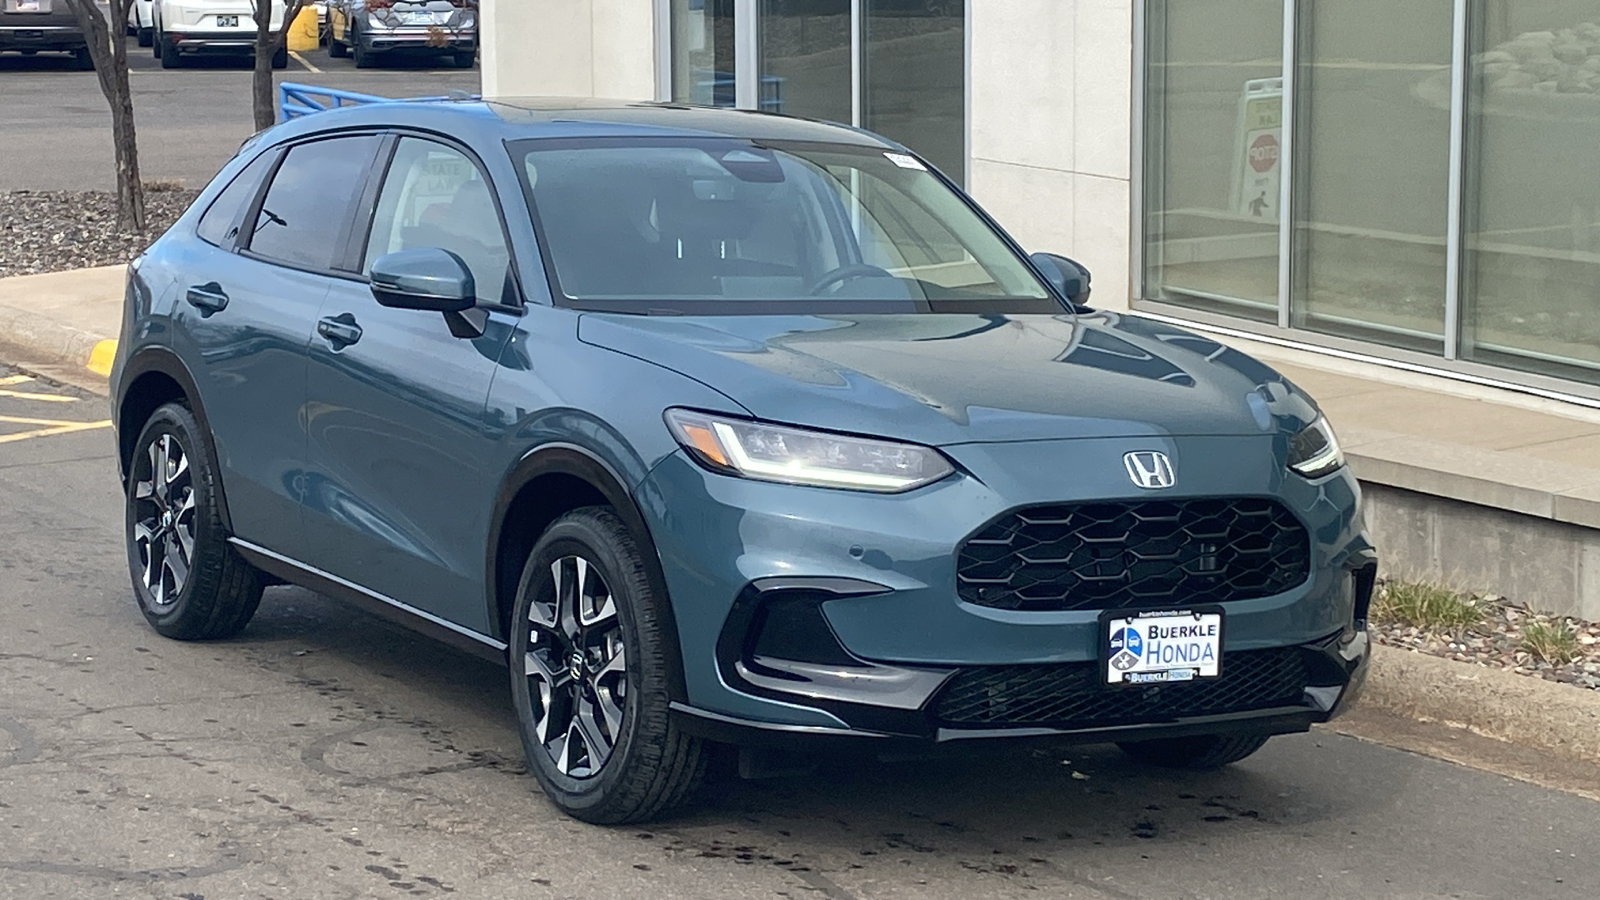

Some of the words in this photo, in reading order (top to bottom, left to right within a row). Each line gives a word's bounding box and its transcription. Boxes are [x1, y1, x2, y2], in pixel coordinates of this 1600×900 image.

[420, 163, 460, 176] STATE
[428, 178, 455, 191] LAW
[1148, 624, 1216, 639] BUERKLE
[1146, 641, 1214, 664] HONDA
